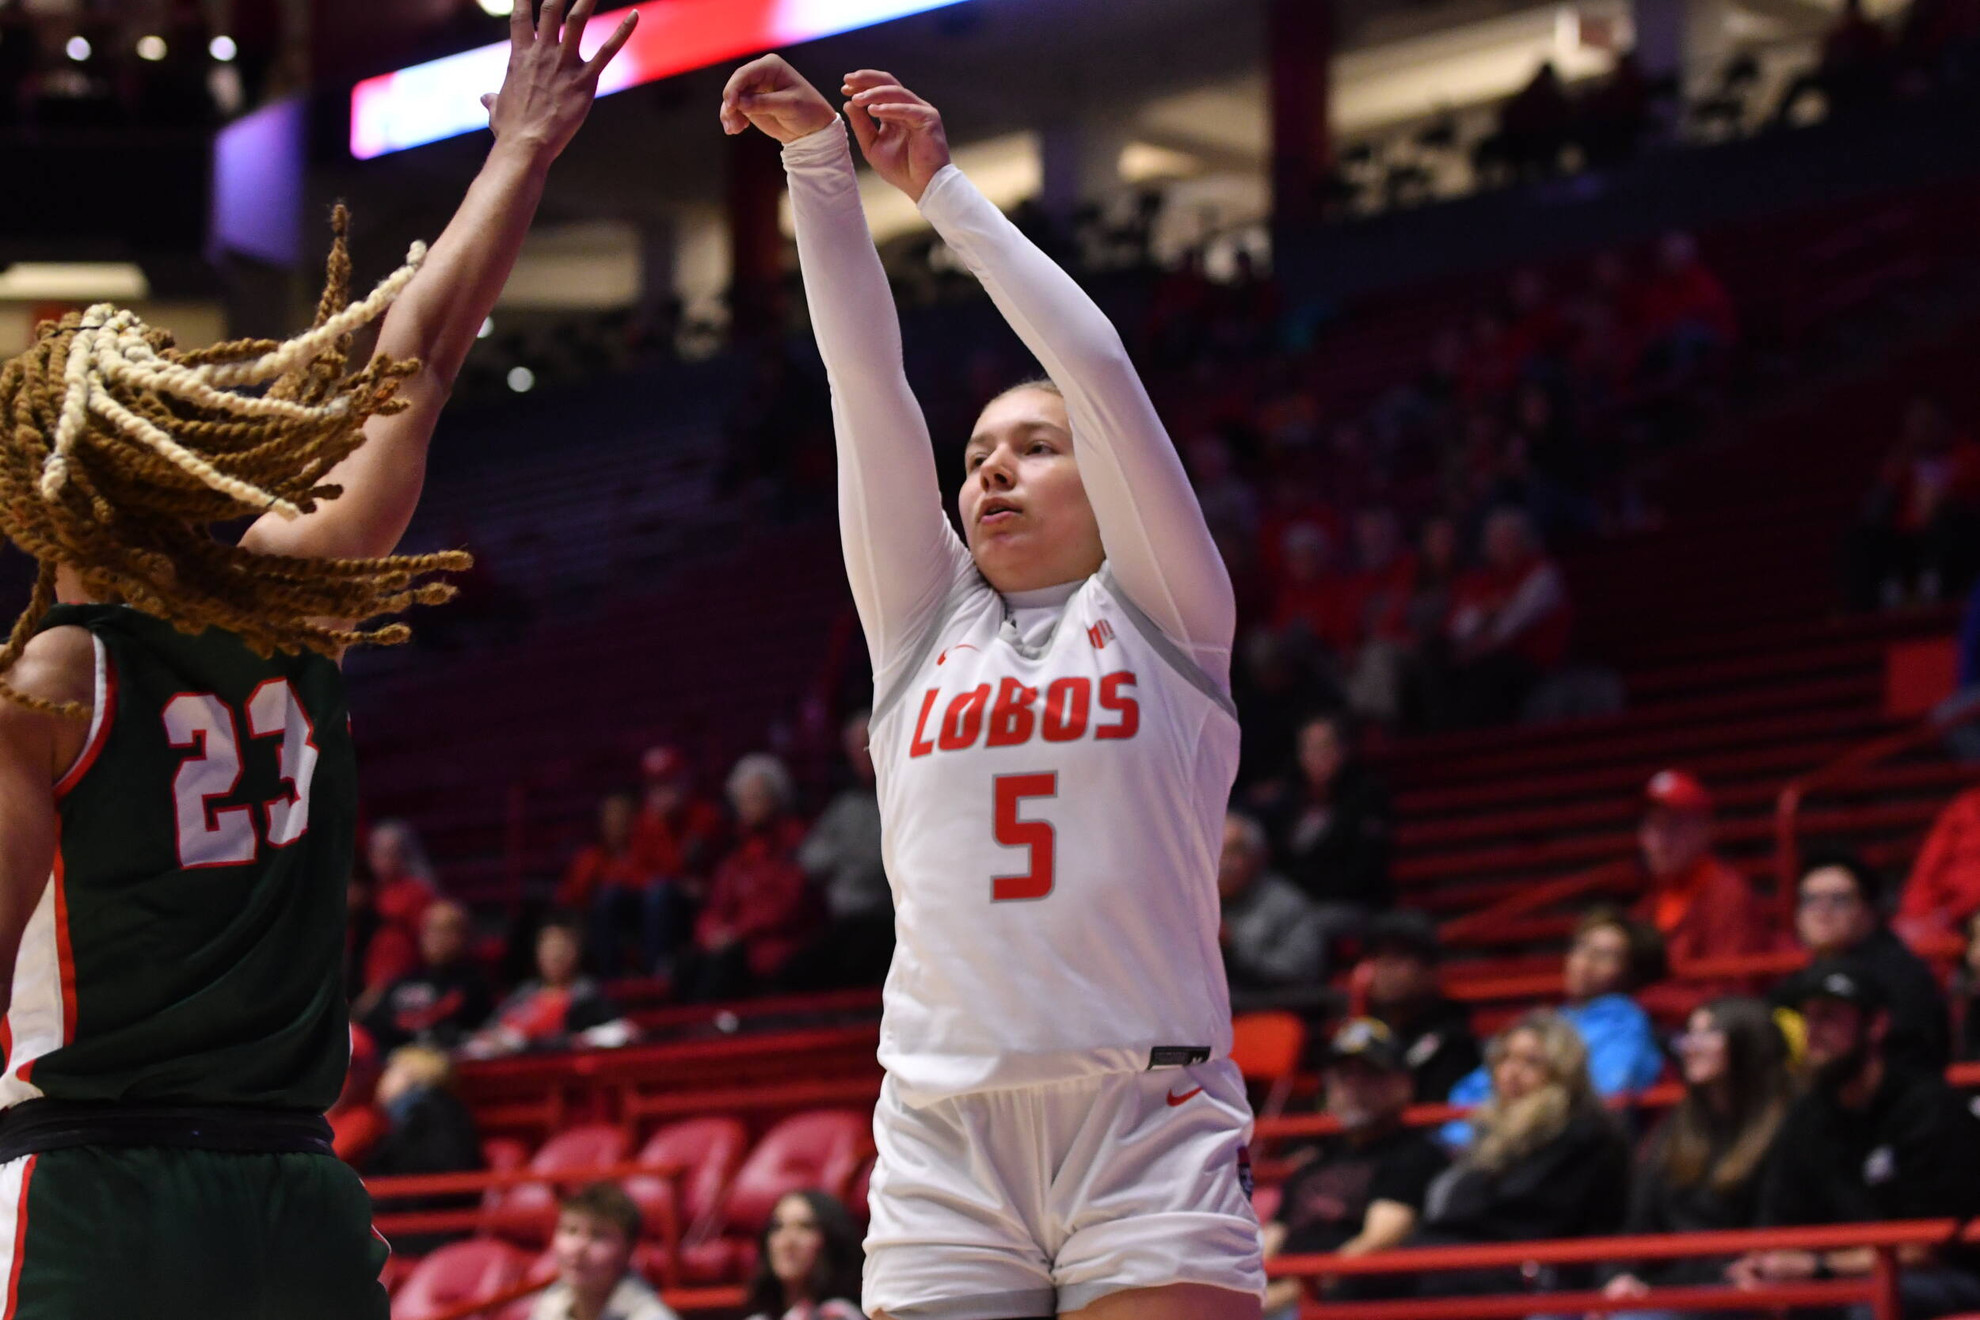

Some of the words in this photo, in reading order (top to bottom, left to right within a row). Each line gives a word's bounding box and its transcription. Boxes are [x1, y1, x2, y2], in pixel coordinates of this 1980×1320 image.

[161, 676, 320, 869] 23
[909, 669, 1140, 759] LOBOS
[990, 770, 1059, 904] 5
